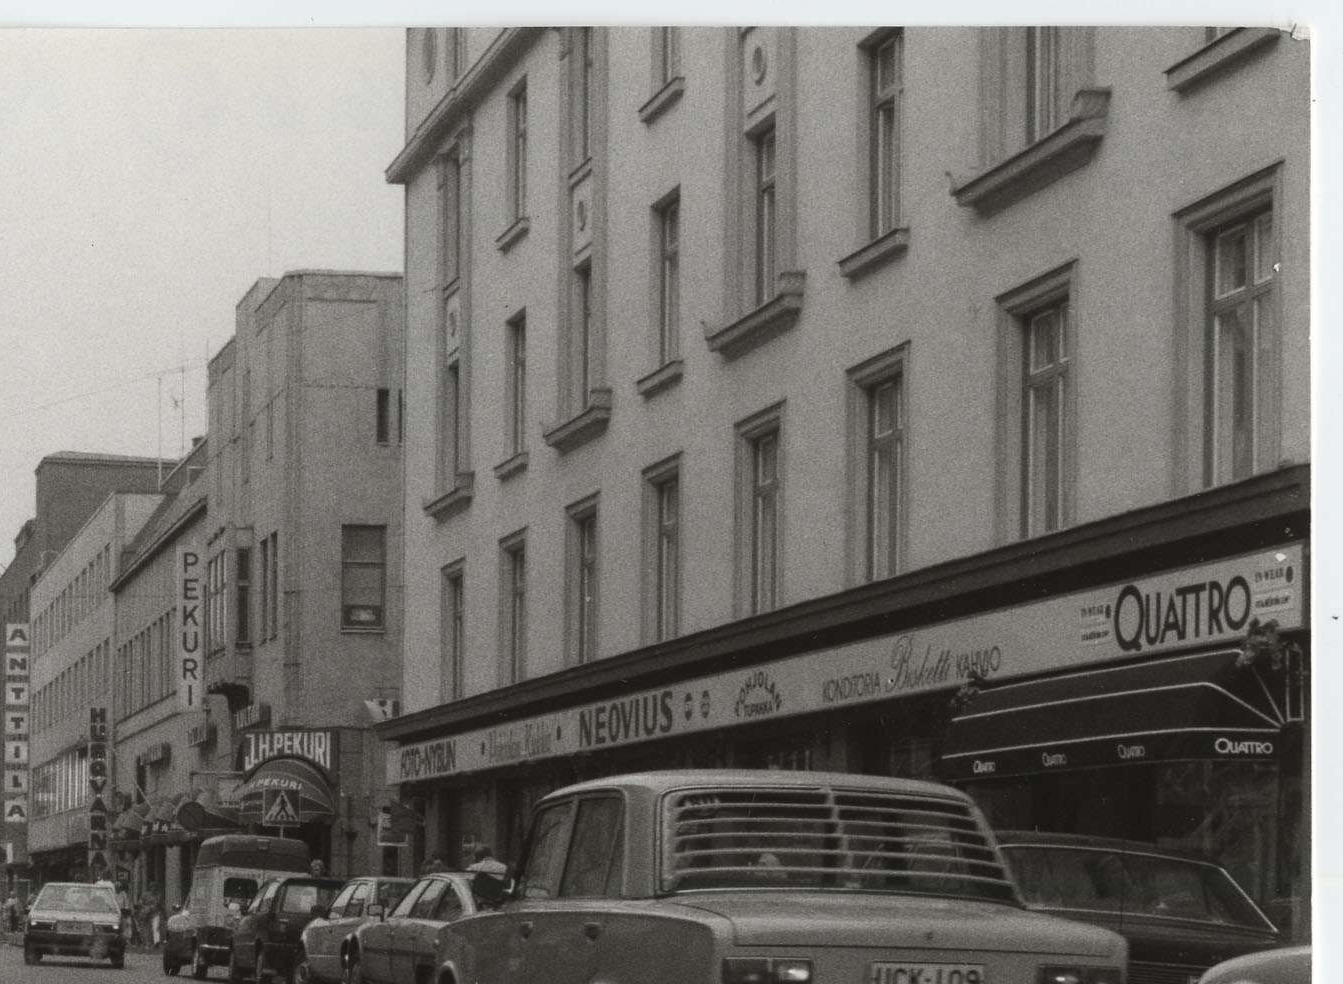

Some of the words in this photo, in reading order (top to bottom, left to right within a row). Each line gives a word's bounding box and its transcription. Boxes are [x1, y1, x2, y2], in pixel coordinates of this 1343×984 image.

[182, 552, 199, 706] PEKURI
[1114, 576, 1251, 652] QUATTRO
[822, 671, 881, 702] KONDITORIA
[956, 646, 1001, 680] KAHVIO
[8, 627, 27, 818] ANTTILA
[579, 690, 673, 748] NEOVIUS
[1215, 738, 1273, 754] QUATTRO
